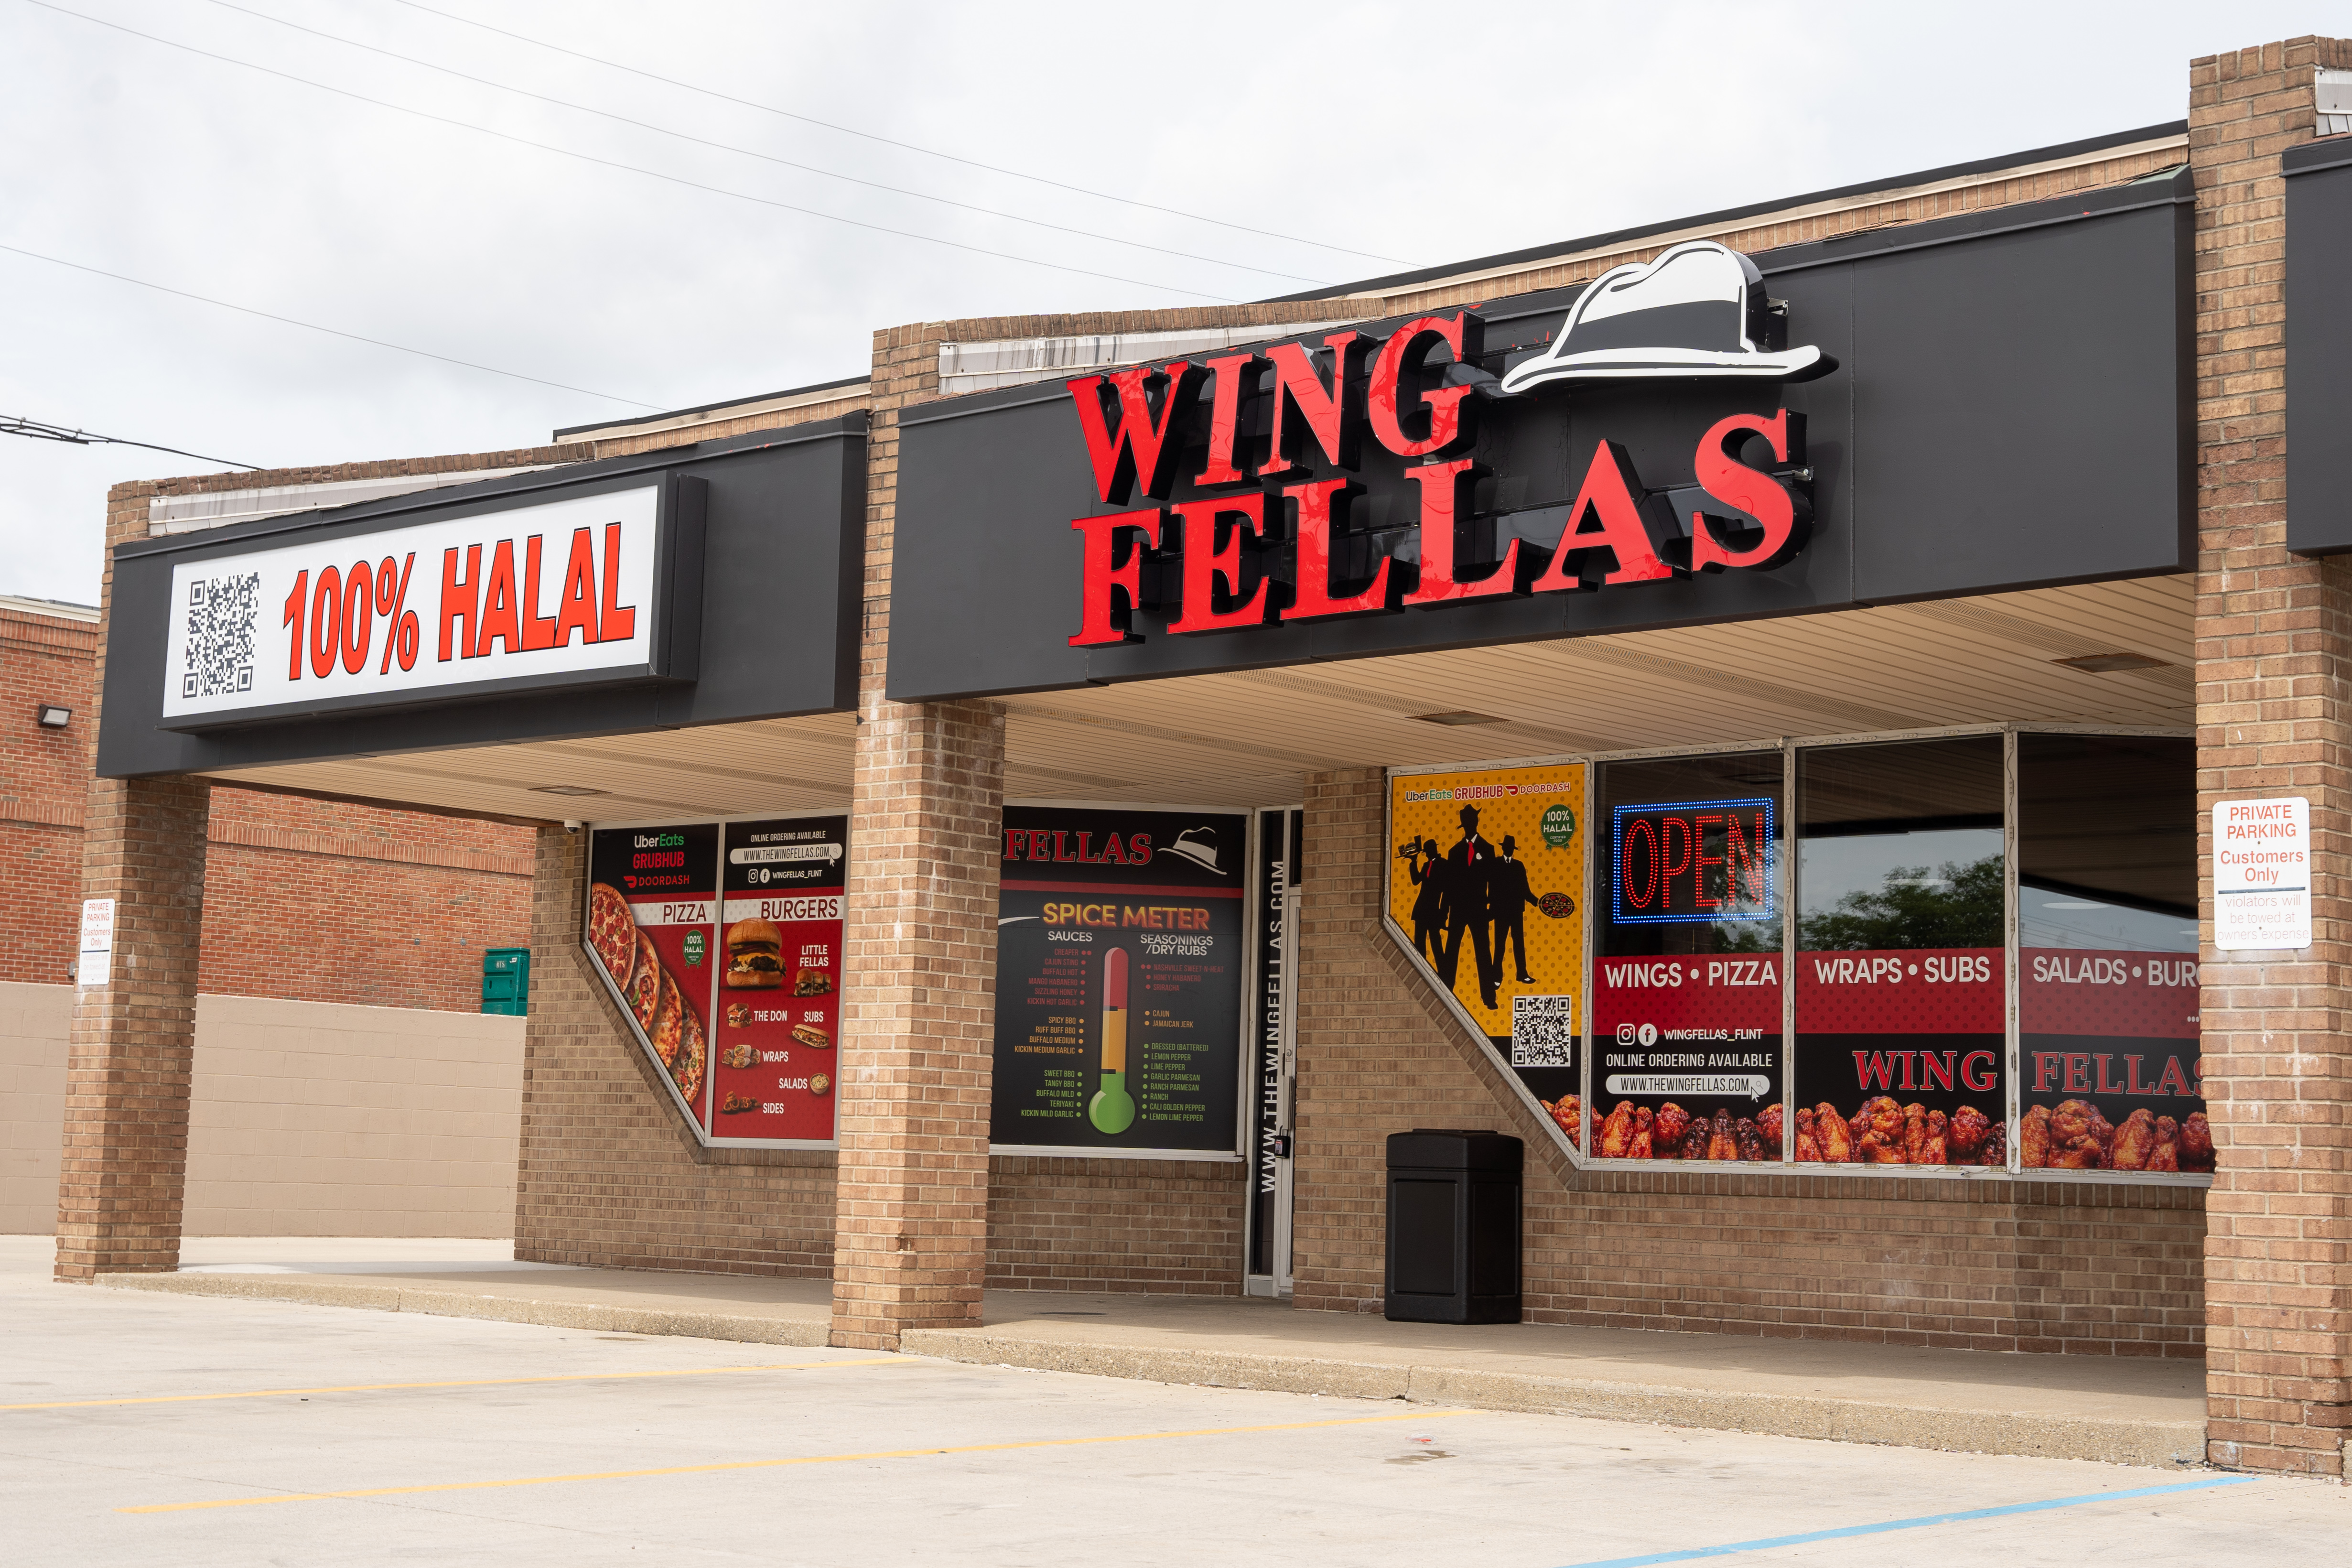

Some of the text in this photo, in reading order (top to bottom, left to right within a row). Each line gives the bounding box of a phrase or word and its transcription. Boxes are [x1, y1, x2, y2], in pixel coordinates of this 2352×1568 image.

[1066, 310, 1473, 504] WING
[1068, 408, 1796, 648] FELLAS
[283, 521, 636, 681] 100% HALAL
[1454, 785, 1503, 800] GRUBHUB
[1520, 782, 1571, 794] DOORDASH
[1547, 810, 1569, 822] 100%
[2230, 804, 2292, 821] PRIVATE
[1543, 823, 1572, 833] HALAL
[2227, 823, 2296, 839] PARKING
[751, 831, 826, 842] ONLINE ORDERING AVAILABLE
[744, 846, 830, 861] WWW.THEWINGFELLAS.COM
[1003, 829, 1153, 865] FELLAS
[633, 851, 684, 869] GRUBHUB
[1622, 812, 1764, 909] OPEN
[2220, 850, 2304, 865] Customers
[639, 875, 690, 886] DOORDASH
[772, 870, 822, 879] WINGFELLAS_FLINT
[2245, 867, 2279, 885] Only
[88, 903, 109, 911] PRIVATE
[2225, 894, 2300, 907] violators will
[663, 904, 707, 923] PIZZA
[761, 898, 838, 919] BURGERS
[86, 913, 109, 922] PARKING
[1043, 902, 1211, 930] SPICE METER
[2230, 911, 2296, 924] be towed at
[83, 928, 110, 936] Customers
[1047, 931, 1093, 942] SAUCES
[2217, 930, 2309, 941] owners expense
[91, 938, 102, 948] Only
[687, 935, 702, 944] 100%
[1140, 934, 1213, 946] SEASONINGS
[801, 945, 828, 955] LITTLE
[1146, 944, 1207, 956] /DRY RUBS
[799, 957, 829, 967] FELLAS
[1604, 961, 1778, 988] WINGS PIZZA
[1814, 956, 1990, 984] WRAPS SUBS
[2033, 956, 2199, 987] SALADS BUR
[754, 1010, 788, 1021] THE DON
[804, 1011, 824, 1022] SUBS
[1663, 1028, 1763, 1042] WINGFELLAS_FLINT
[762, 1051, 788, 1062] WRAPS
[1606, 1053, 1773, 1067] ONLINE ORDERING AVAILABLE
[1853, 1050, 1998, 1092] WING
[779, 1078, 808, 1089] SALADS
[1620, 1077, 1750, 1092] WWW.THEWINGFELLAS.COM
[763, 1103, 784, 1114] SIDES
